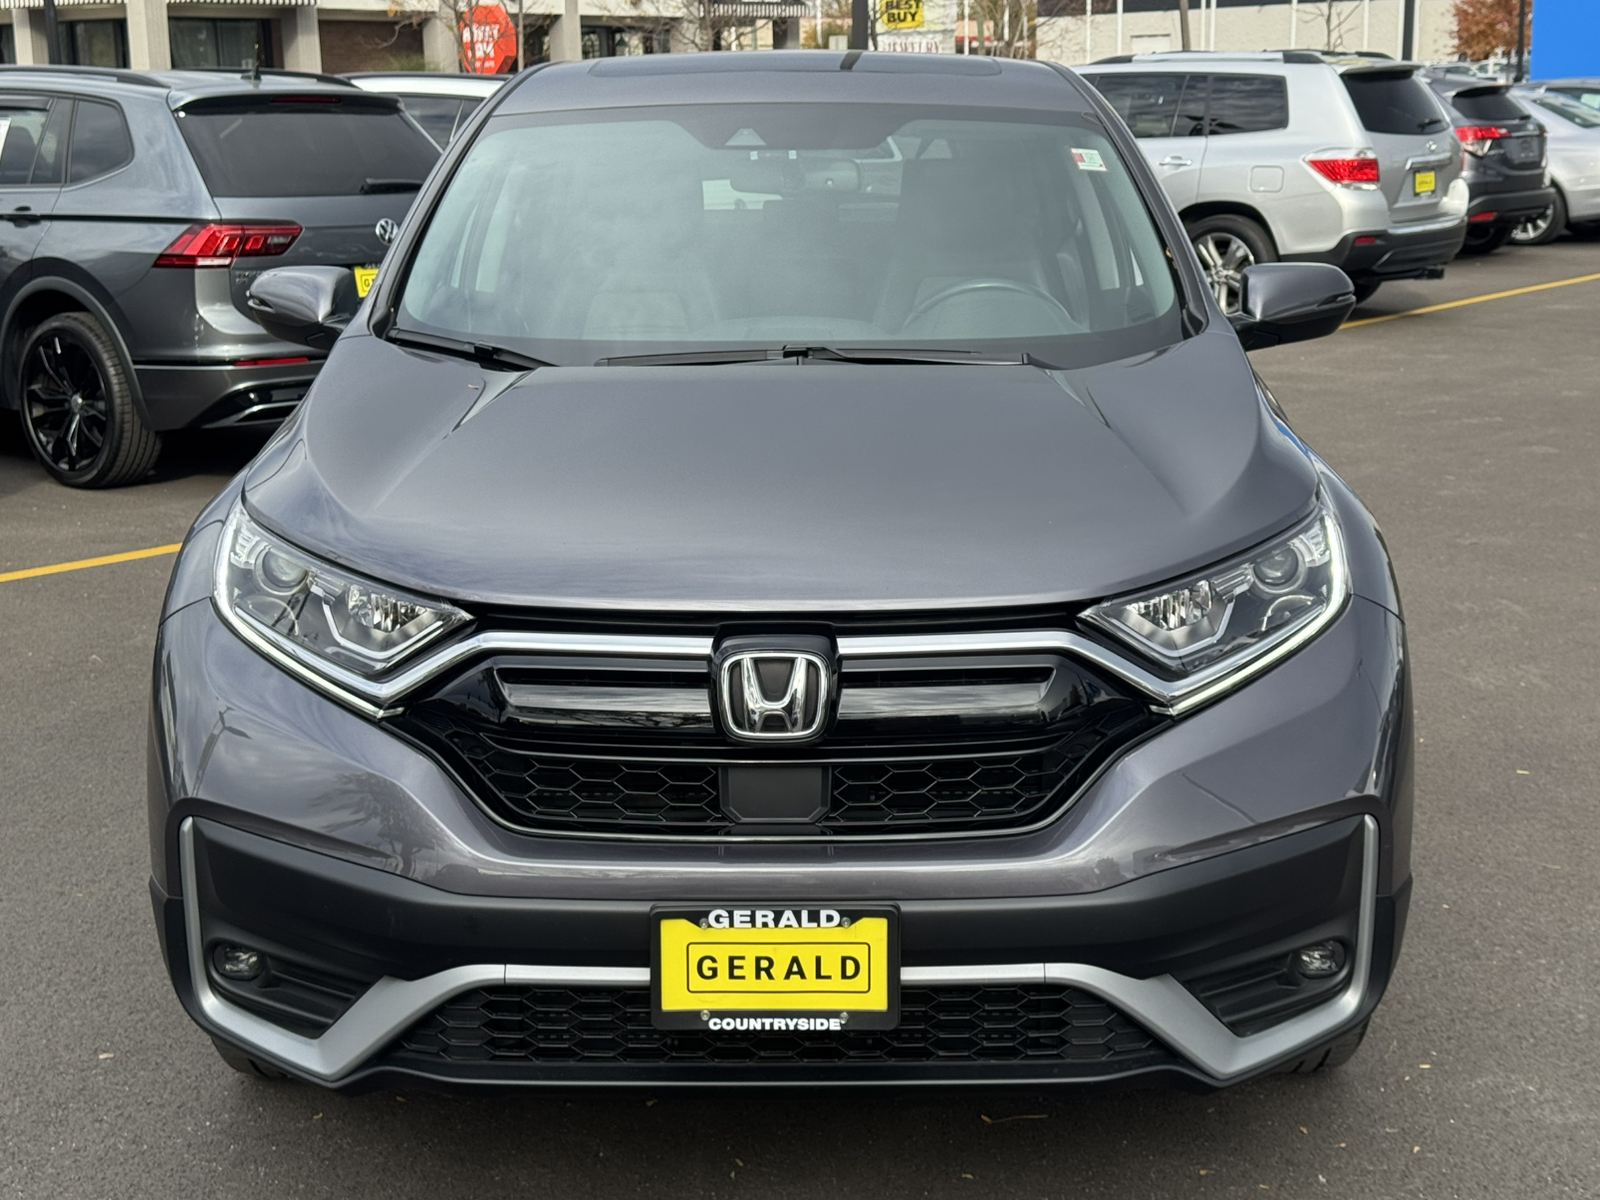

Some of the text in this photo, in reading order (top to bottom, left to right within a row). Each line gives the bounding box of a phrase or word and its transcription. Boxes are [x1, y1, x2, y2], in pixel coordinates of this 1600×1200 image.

[886, 0, 921, 10] BEST
[887, 11, 918, 23] BUY
[708, 909, 841, 929] GERALD
[696, 955, 861, 981] GERALD
[708, 1017, 842, 1031] COUNTRYSIDE
